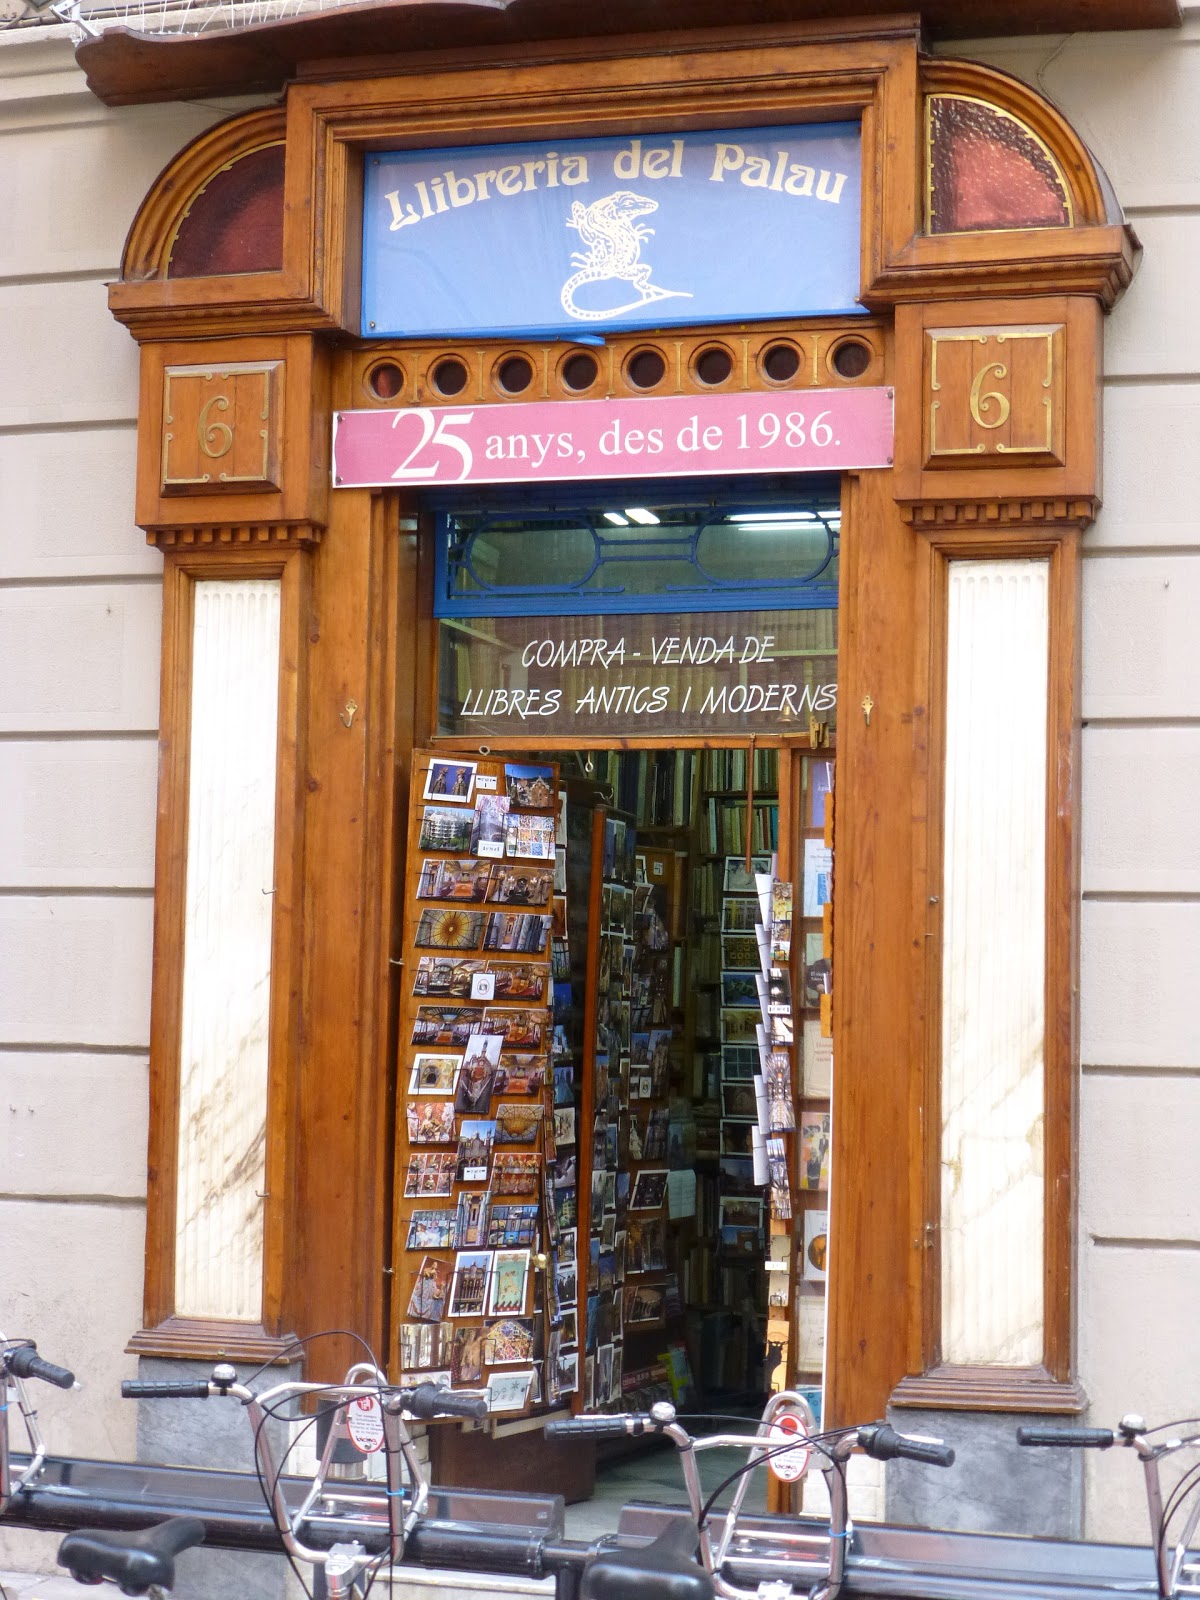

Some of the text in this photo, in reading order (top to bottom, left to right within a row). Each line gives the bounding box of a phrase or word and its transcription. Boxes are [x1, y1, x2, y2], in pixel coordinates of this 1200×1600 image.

[384, 138, 849, 233] Llibreria del Palau
[197, 395, 233, 459] 6
[972, 361, 1010, 430] 6
[390, 408, 842, 482] 25 anys, des de 1986.
[521, 637, 627, 670] COMPRA
[651, 635, 736, 666] VENDA
[738, 635, 775, 664] DE
[460, 683, 838, 720] LLIBRES ANTICS I MODERNS
